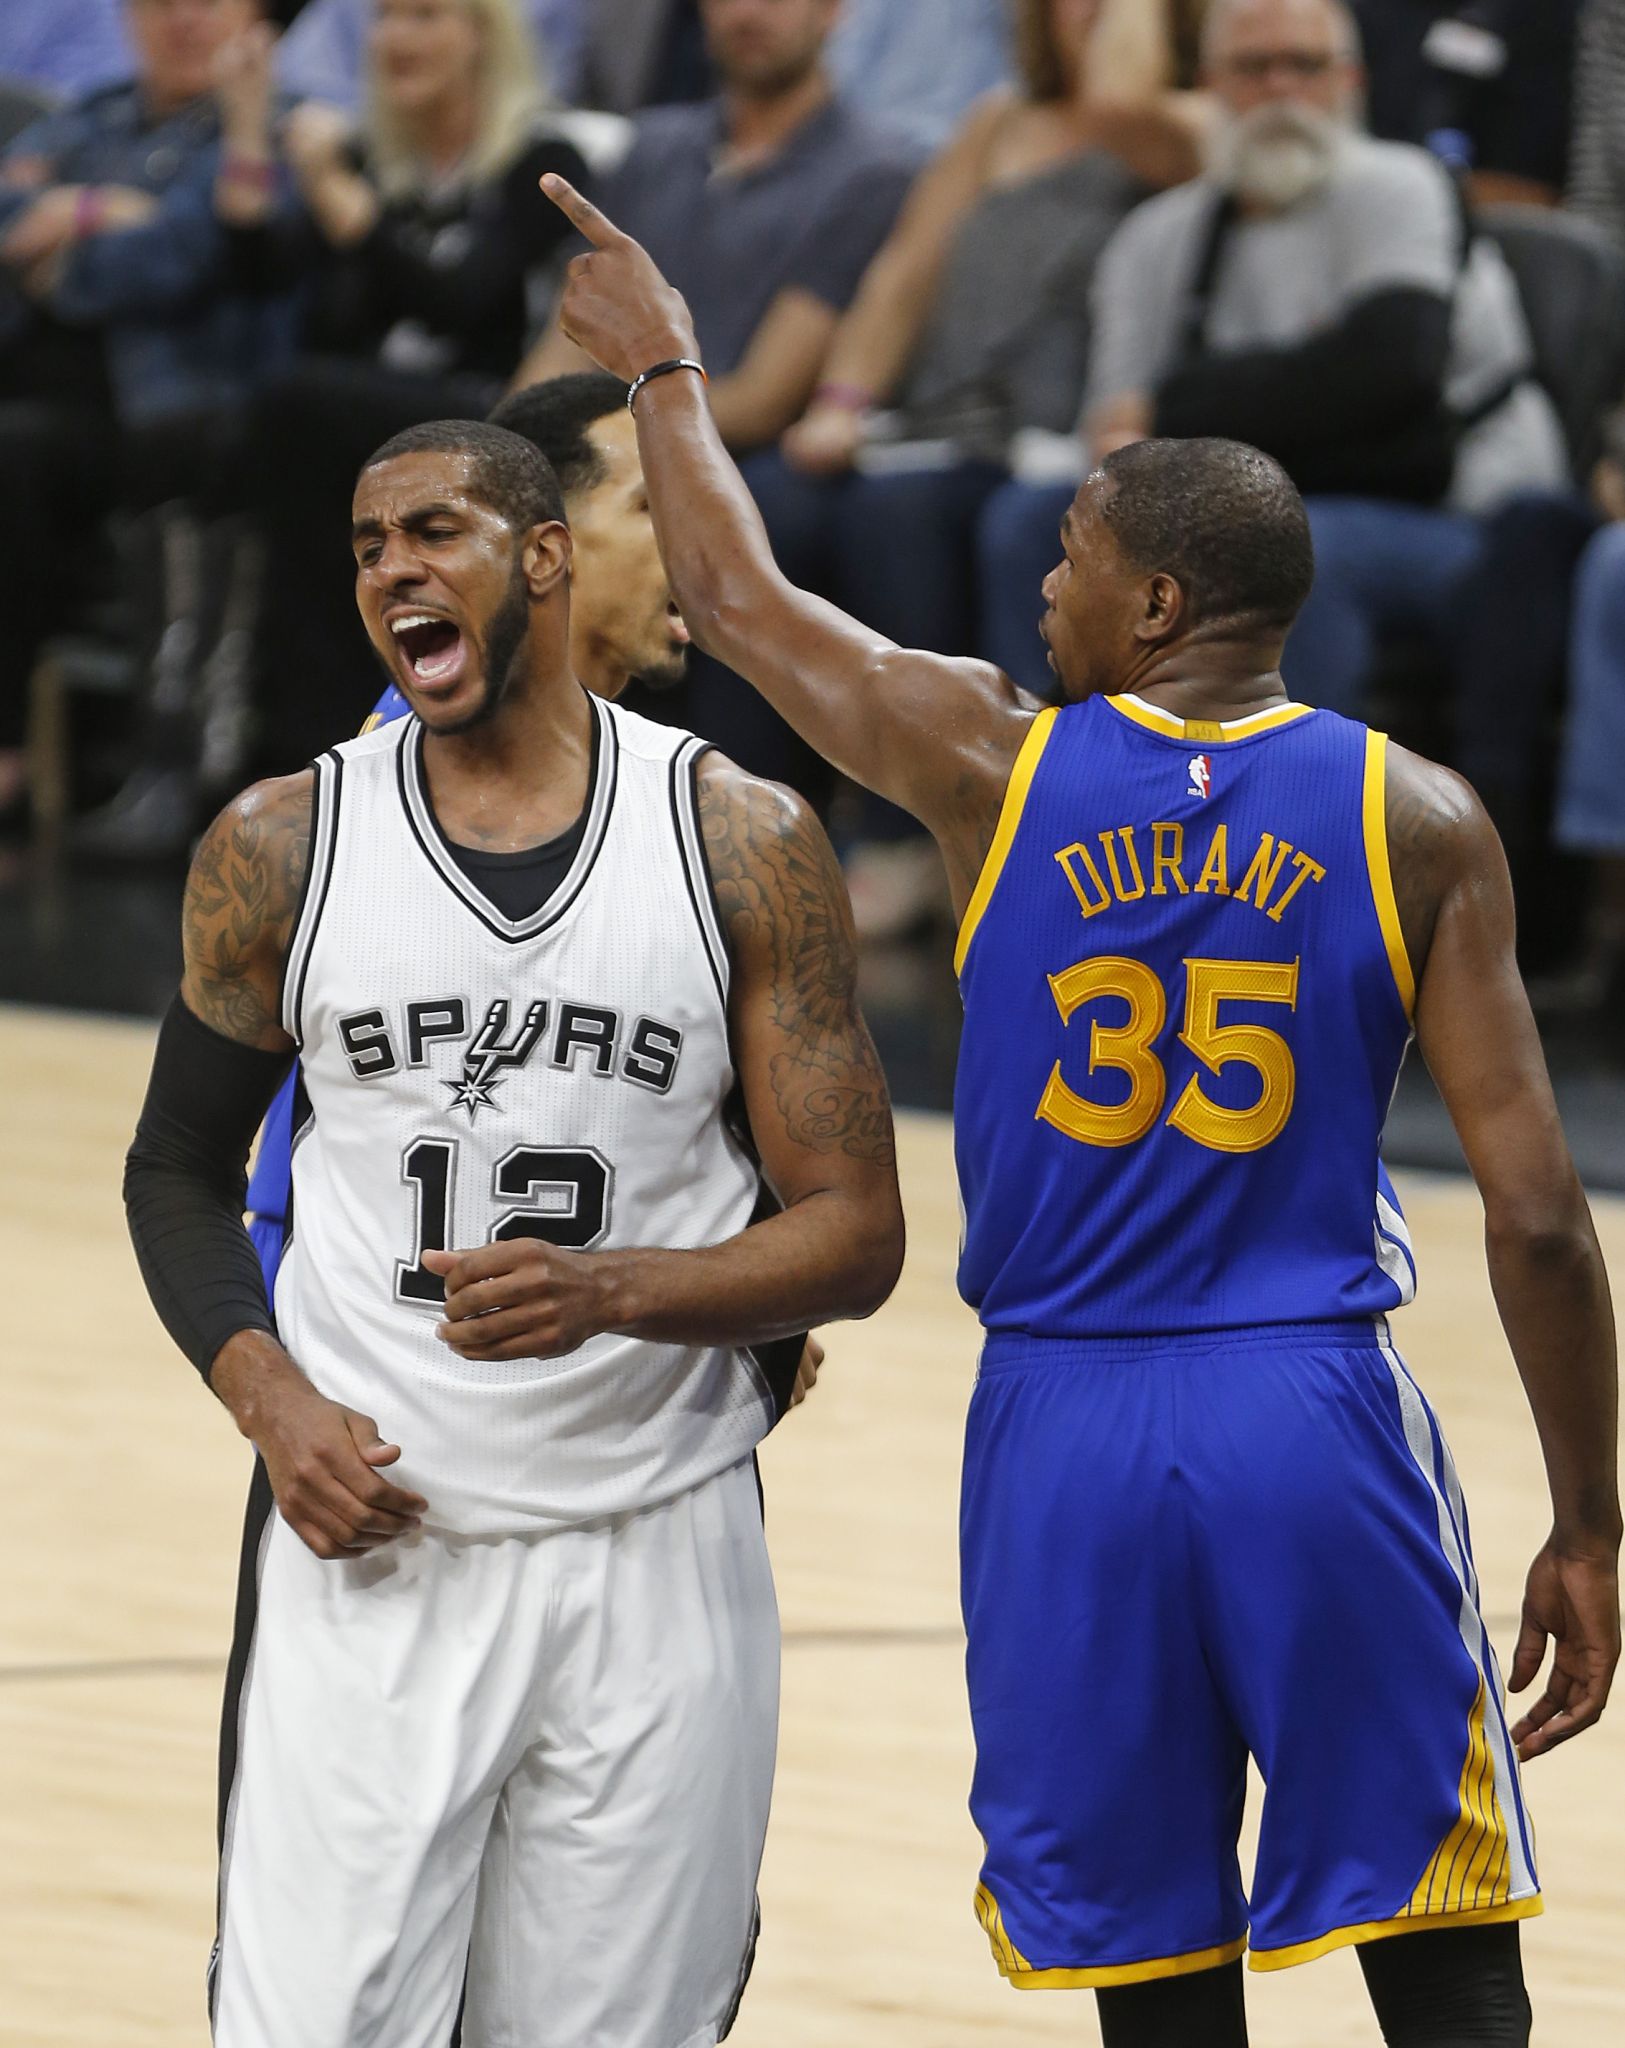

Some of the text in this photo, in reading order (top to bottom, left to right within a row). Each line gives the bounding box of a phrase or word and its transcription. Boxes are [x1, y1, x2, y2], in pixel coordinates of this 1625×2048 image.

[1054, 821, 1327, 923] DURANT
[335, 993, 684, 1100] SPURS
[1035, 955, 1301, 1154] 35
[393, 1134, 616, 1313] 12
